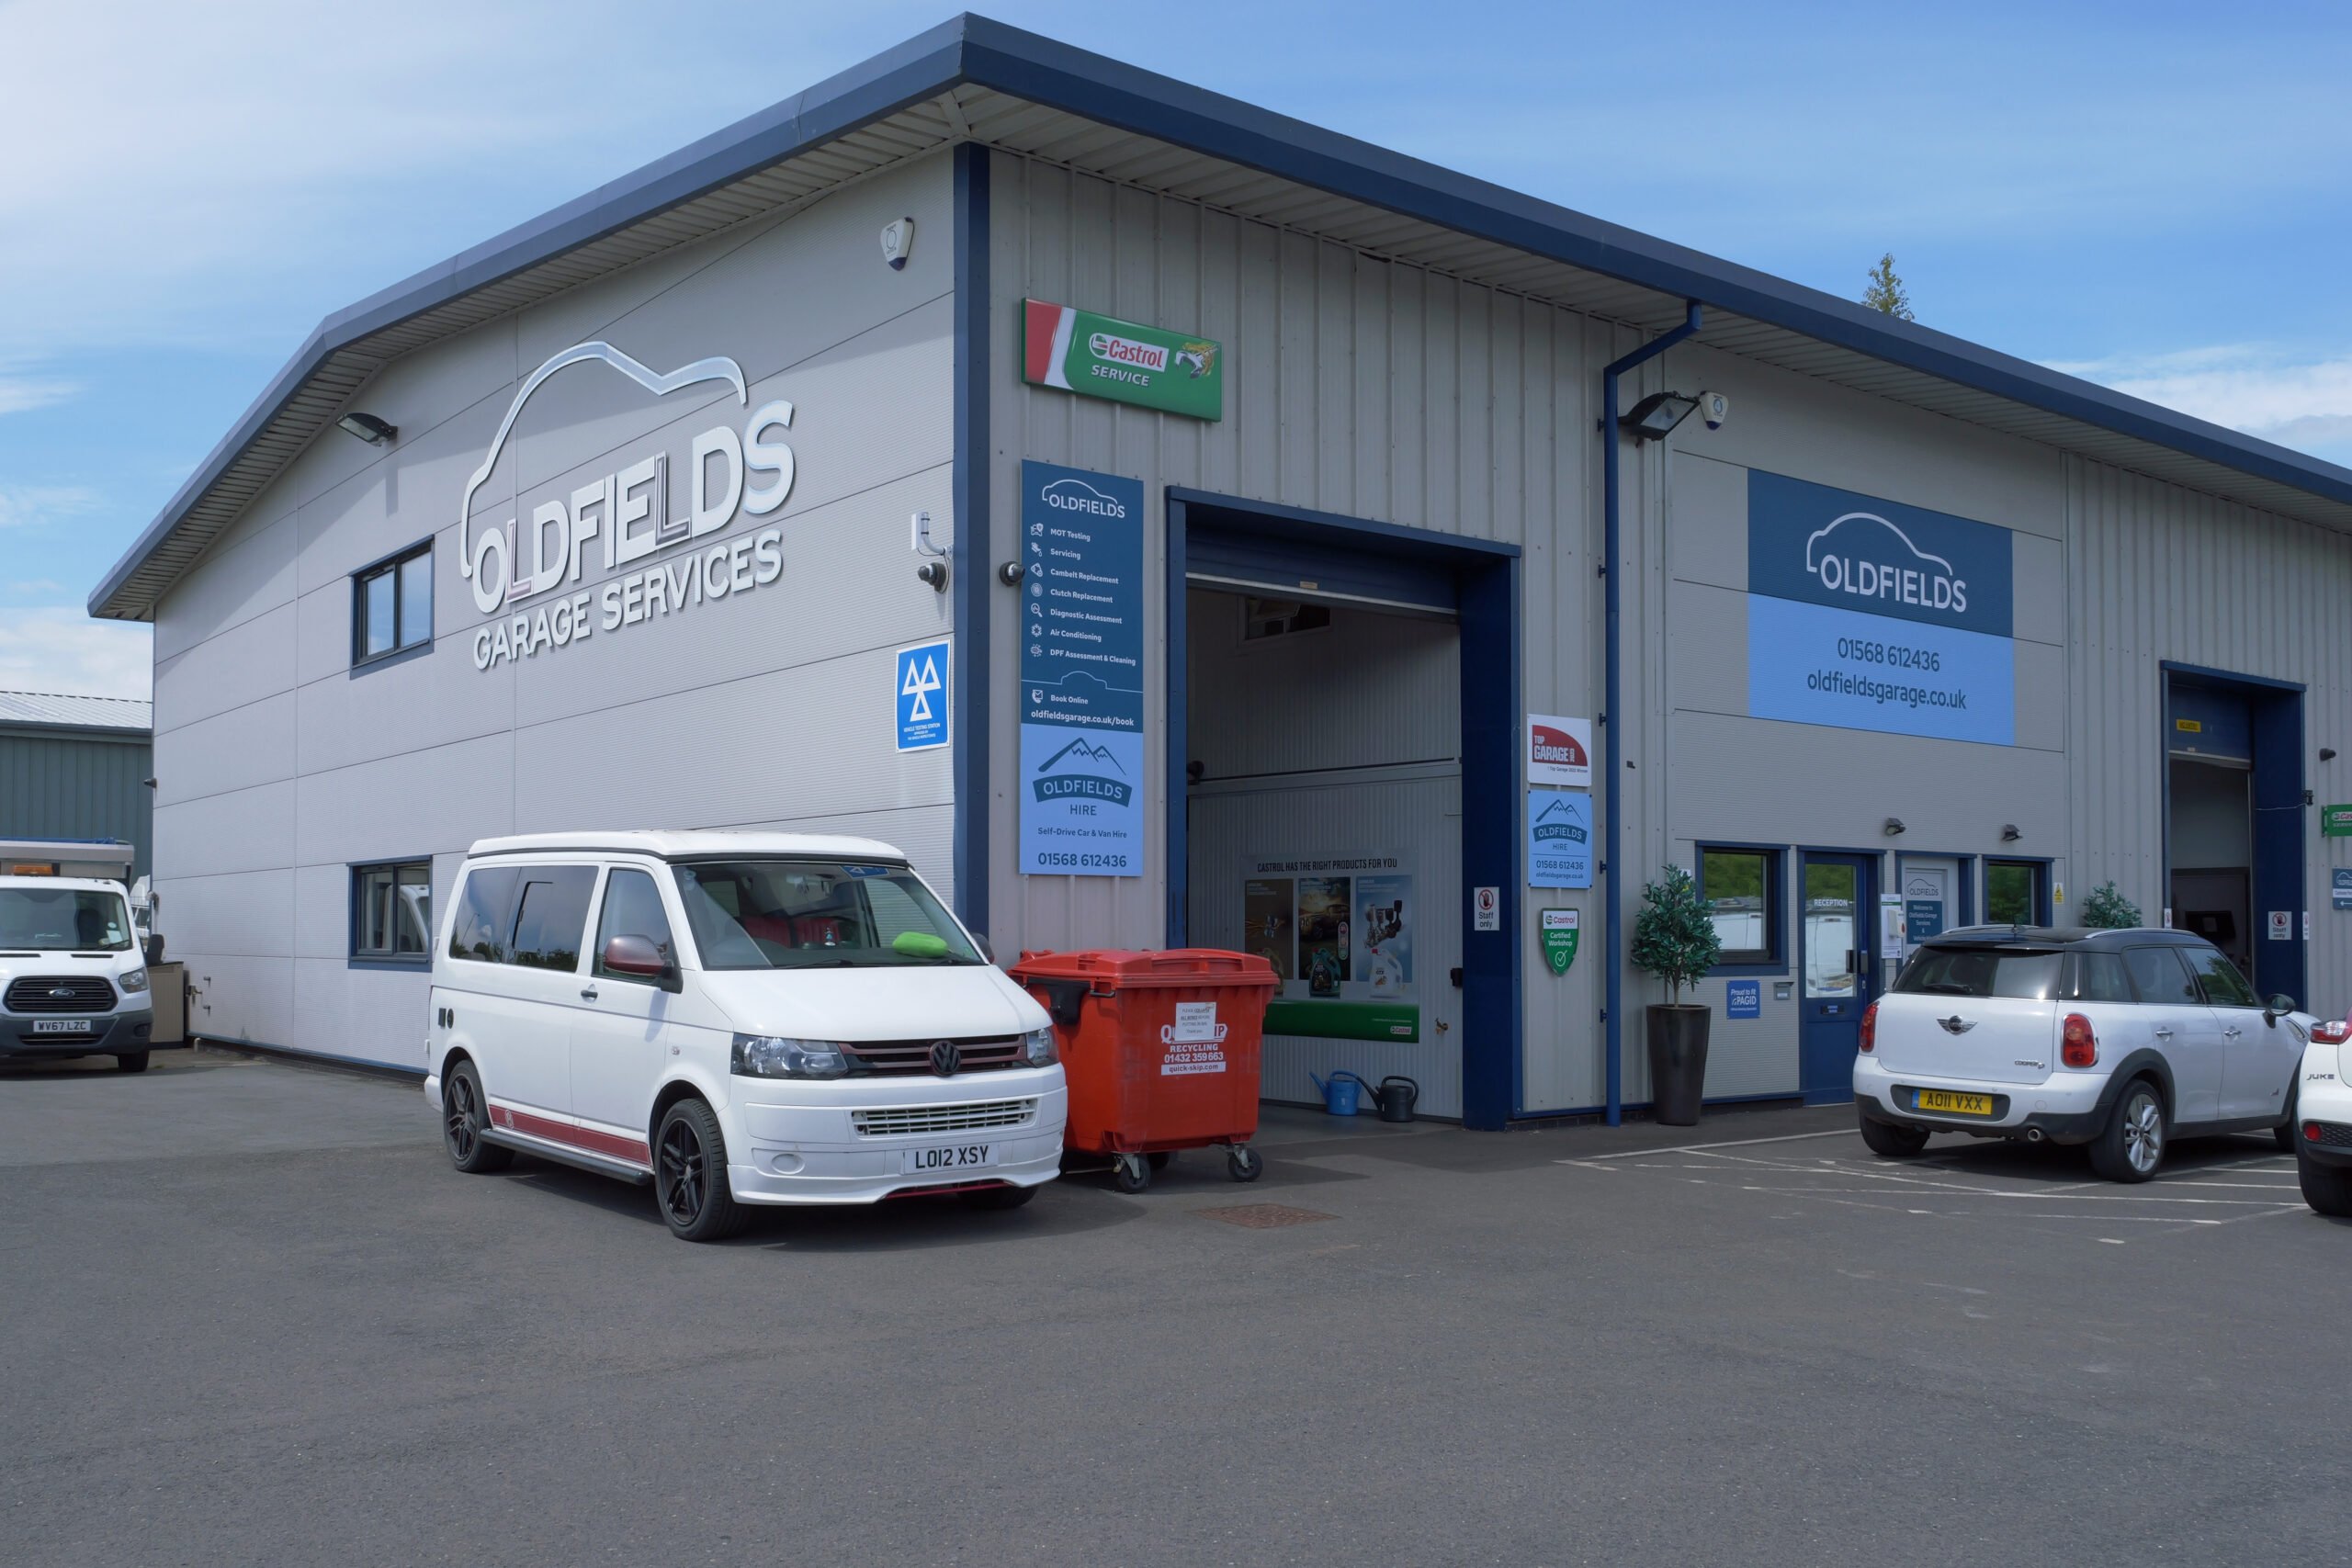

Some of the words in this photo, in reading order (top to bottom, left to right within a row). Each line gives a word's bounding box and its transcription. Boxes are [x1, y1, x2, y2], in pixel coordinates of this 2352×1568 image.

[1109, 339, 1163, 368] Castrol
[1091, 365, 1149, 387] SERVICE
[471, 400, 795, 613] OLDFIELDS
[1049, 494, 1125, 518] OLDFIELDS
[1050, 528, 1066, 537] MOT
[1067, 531, 1091, 542] Testing
[1050, 548, 1081, 560] Servicing
[1050, 569, 1078, 579] Cambelt
[1079, 571, 1119, 584] Replacement
[1820, 554, 1967, 613] OLDFIELDS
[472, 592, 592, 670] GARAGE
[602, 529, 783, 630] SERVICES
[1050, 589, 1072, 598] Clutch
[1072, 592, 1114, 603] Replacement
[1050, 609, 1084, 619] Diagnostic
[1085, 613, 1123, 624] Assessment
[1061, 630, 1102, 642] Conditioning
[1050, 649, 1064, 657] DPF
[1066, 651, 1103, 661] Assessment
[1109, 656, 1136, 666] Cleaning
[1838, 637, 1884, 664] 01568
[1887, 646, 1940, 671] 612436
[1807, 670, 1967, 709] oldfieldsgarage.co.uk
[1050, 694, 1068, 703] Book
[1069, 696, 1089, 705] Online
[1031, 710, 1135, 726] oldfieldsgarage.co.uk/book
[1534, 735, 1545, 744] TOP
[1534, 745, 1569, 761] GARAGE
[1044, 780, 1123, 799] OLDFIELDS
[1069, 805, 1097, 816] HIRE
[1037, 828, 1076, 837] Self-Drive
[1078, 829, 1091, 837] Car
[1538, 827, 1582, 840] OLDFIELDS
[1037, 852, 1078, 865] 01568
[1080, 853, 1127, 867] 612436
[1258, 863, 1285, 873] CASTROL
[1286, 862, 1298, 872] HAS
[1299, 861, 1312, 871] THE
[1312, 860, 1331, 871] RIGHT
[1332, 859, 1367, 870] PRODUCTS
[1368, 858, 1382, 868] FOR
[1384, 858, 1397, 867] YOU
[1536, 860, 1557, 869] 01568
[1559, 861, 1584, 870] 612436
[1480, 920, 1493, 929] only
[1553, 916, 1575, 924] Castrol
[1736, 996, 1757, 1005] PAGID
[38, 1021, 64, 1031] WV67
[67, 1021, 86, 1031] LZC
[1170, 1043, 1218, 1053] RECYCLING
[1164, 1054, 1191, 1063] 01432
[1169, 1065, 1218, 1073] quick-skip.com
[1926, 1092, 1951, 1108] AO11
[1955, 1094, 1984, 1111] VXX
[915, 1148, 954, 1169] LO12
[957, 1145, 989, 1166] XSY
